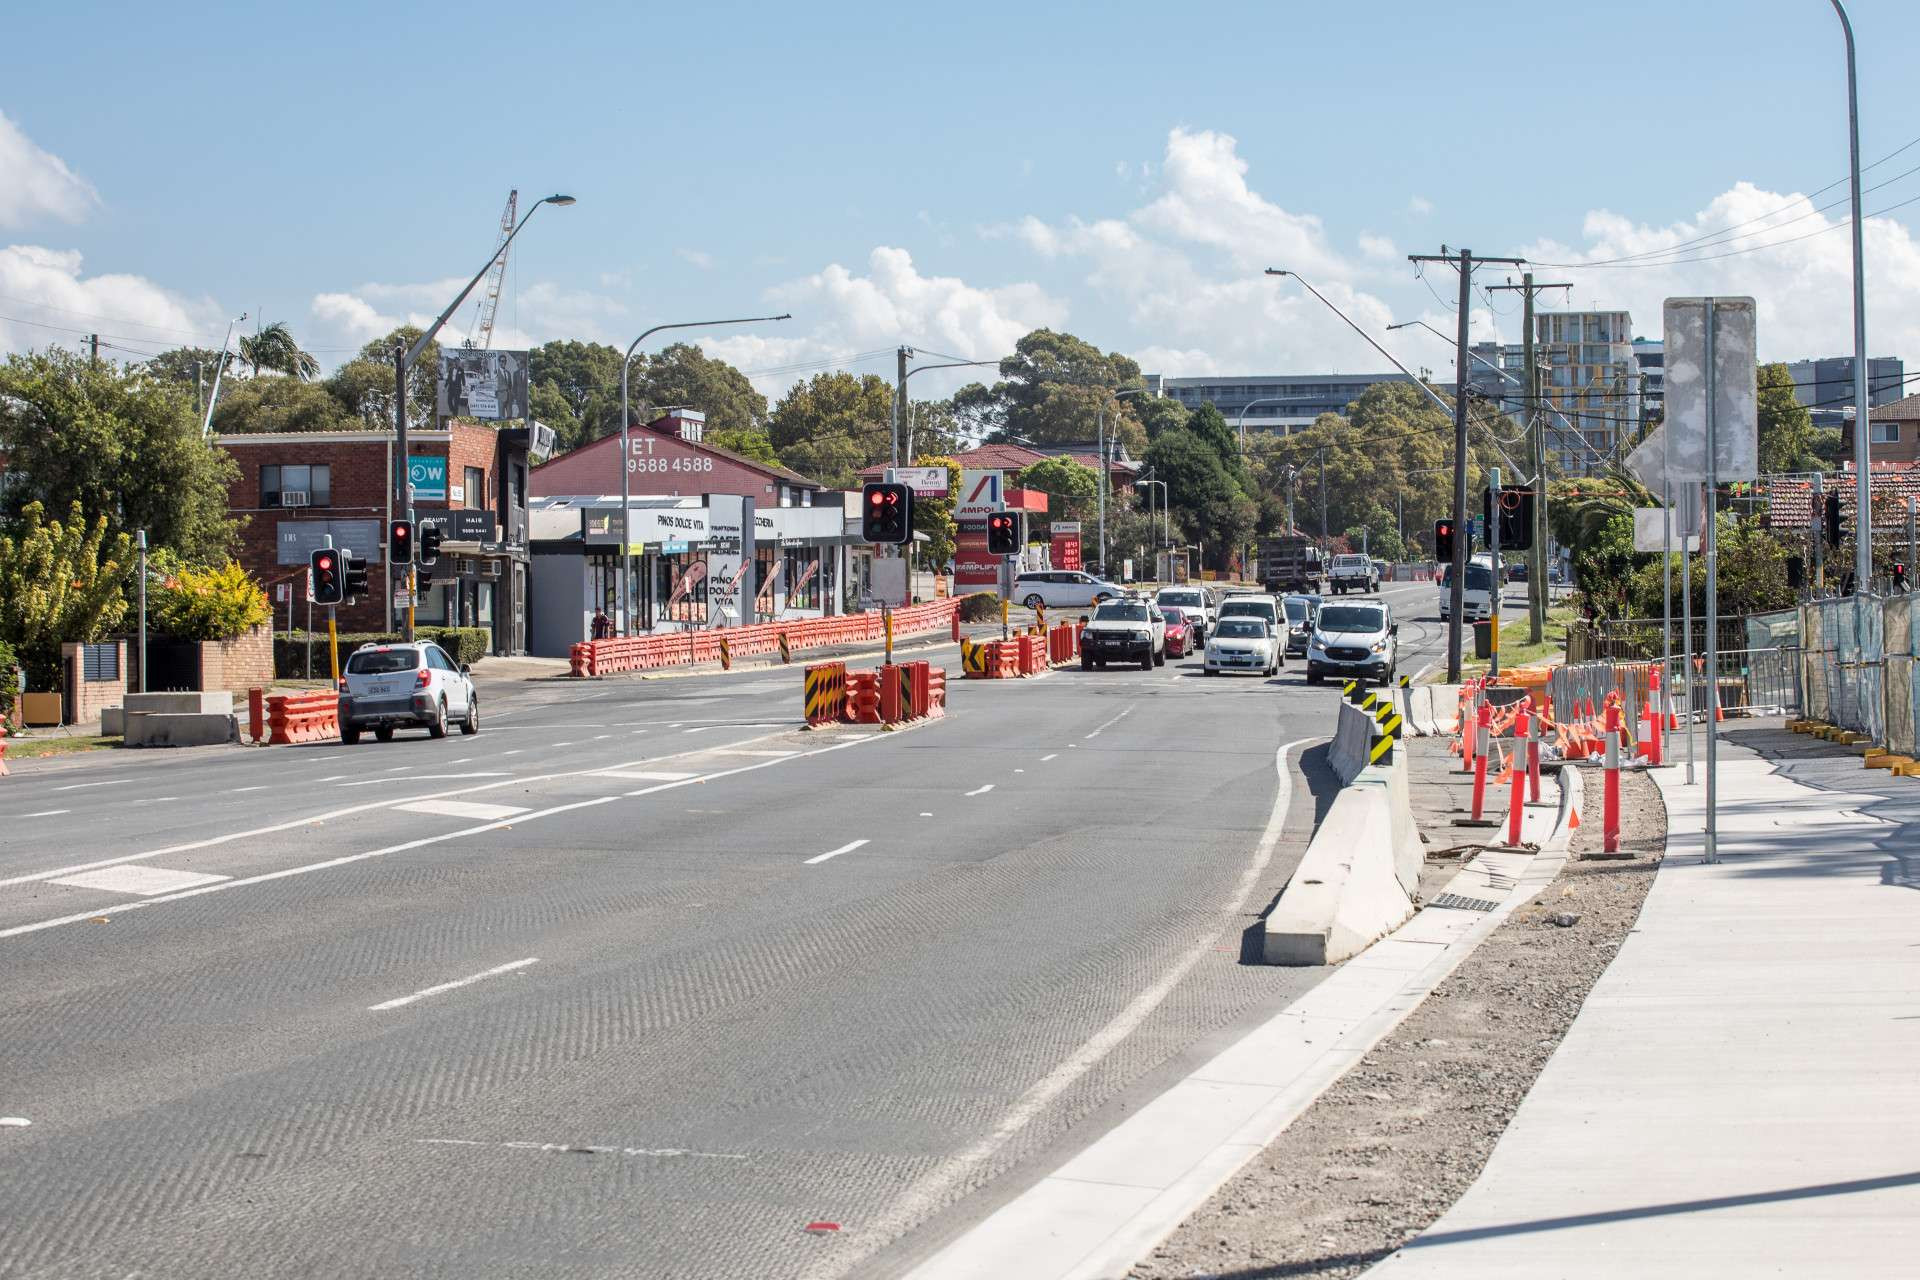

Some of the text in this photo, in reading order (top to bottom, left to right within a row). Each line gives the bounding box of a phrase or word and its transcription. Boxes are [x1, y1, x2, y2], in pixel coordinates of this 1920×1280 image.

[619, 438, 656, 455] VET
[628, 457, 713, 473] 9588 4588
[657, 514, 704, 531] PINOS DOLCE VITA
